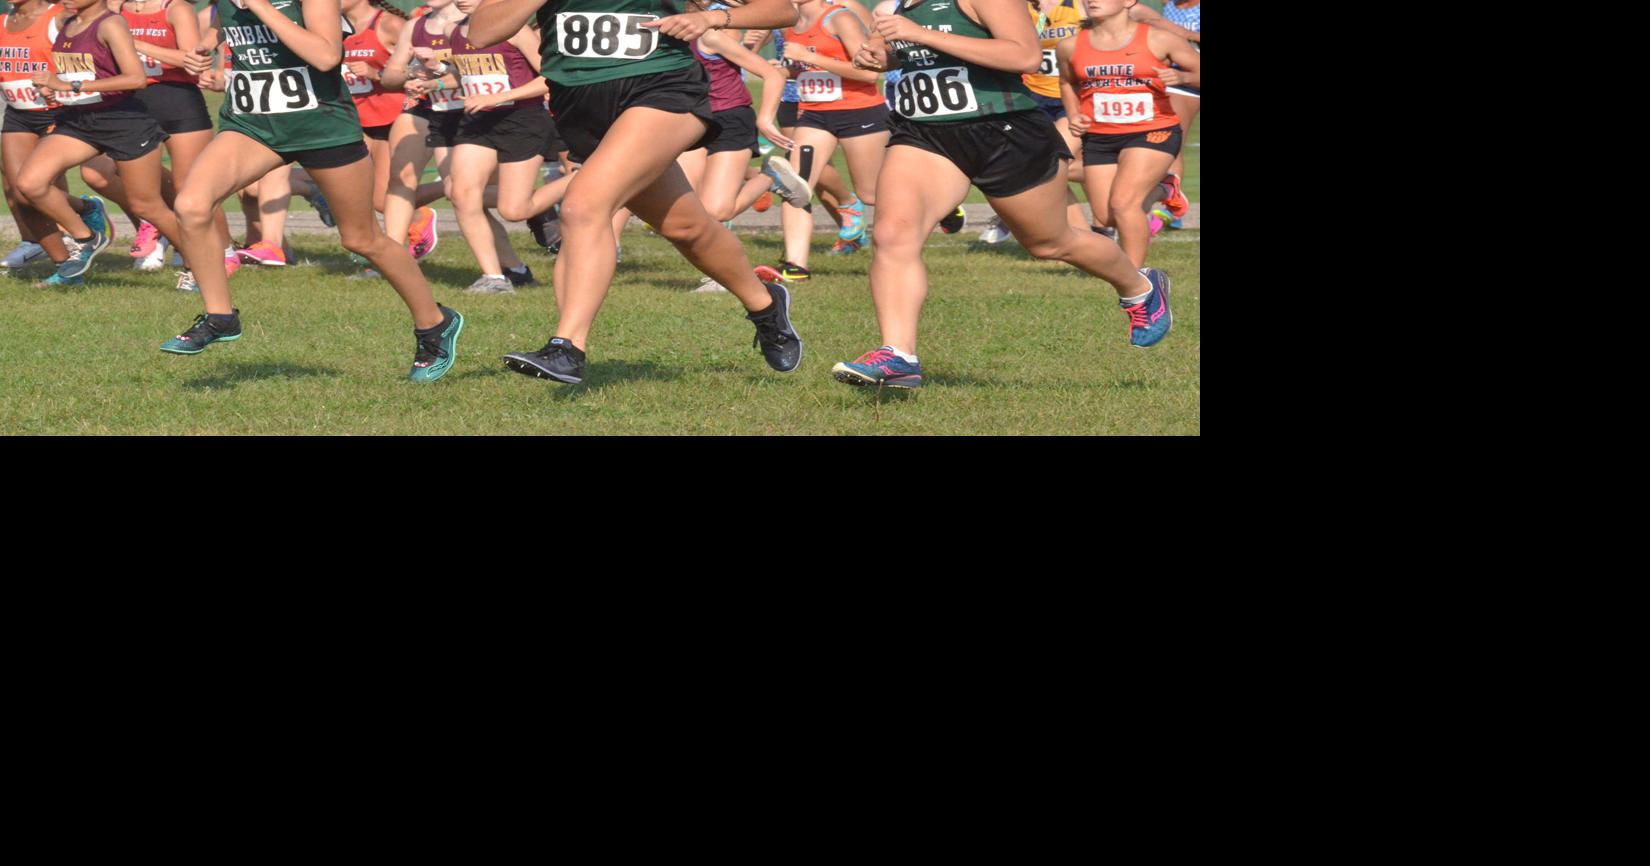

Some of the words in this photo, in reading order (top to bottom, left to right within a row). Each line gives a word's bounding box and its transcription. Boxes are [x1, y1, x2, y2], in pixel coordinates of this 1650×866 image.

[563, 14, 653, 57] 885
[246, 48, 272, 65] CC
[351, 49, 376, 57] WEST
[1086, 64, 1133, 77] WHITE
[233, 69, 310, 113] 879
[801, 78, 834, 95] 1939
[897, 69, 969, 117] 886
[1101, 101, 1145, 116] 1934
